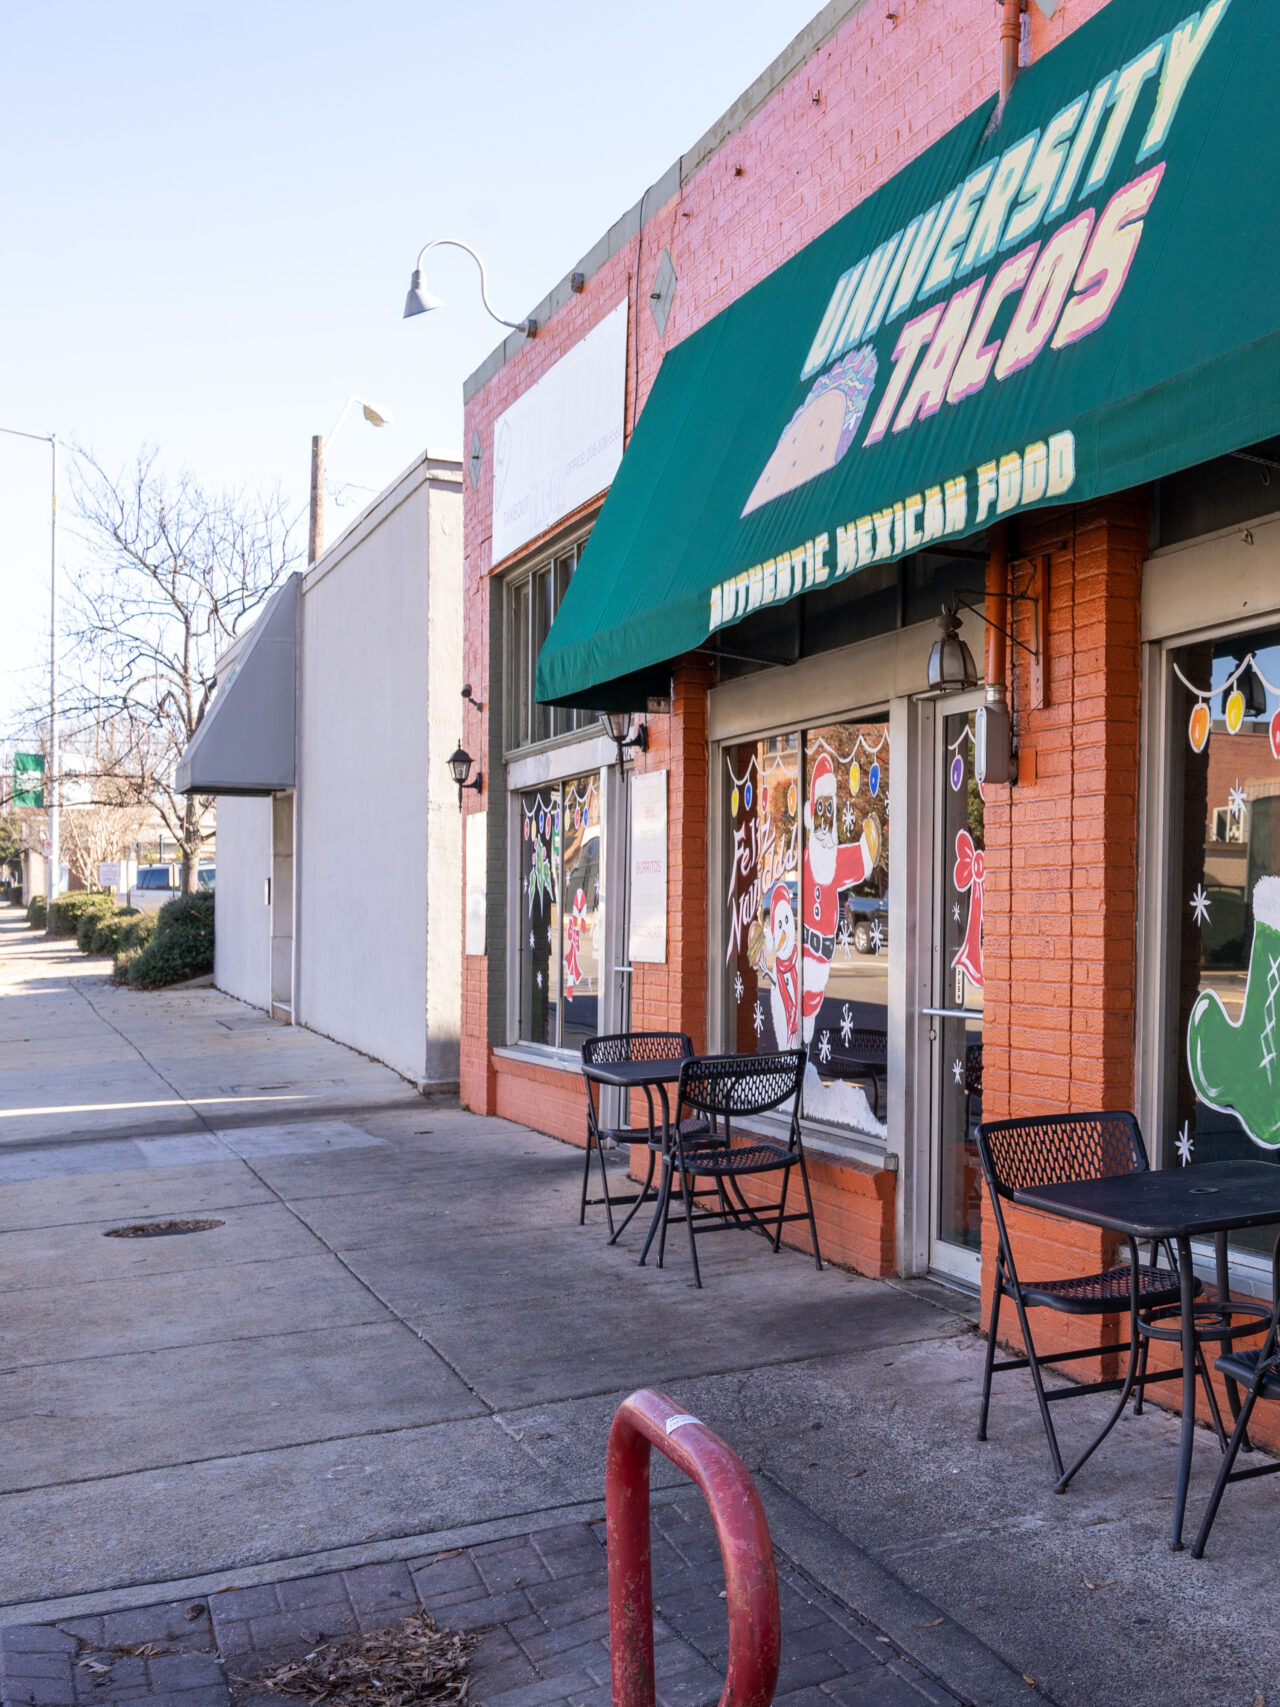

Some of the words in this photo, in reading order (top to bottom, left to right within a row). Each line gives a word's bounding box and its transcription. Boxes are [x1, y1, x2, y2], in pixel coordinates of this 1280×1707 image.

[800, 0, 1233, 381] UNIVERSITY
[862, 161, 1166, 448] TACOS
[709, 532, 830, 632] AUTHENTIC
[835, 475, 968, 577] MEXICAN
[975, 429, 1076, 524] FOOD
[636, 859, 662, 876] BURRITOS
[727, 813, 776, 907] Feliz
